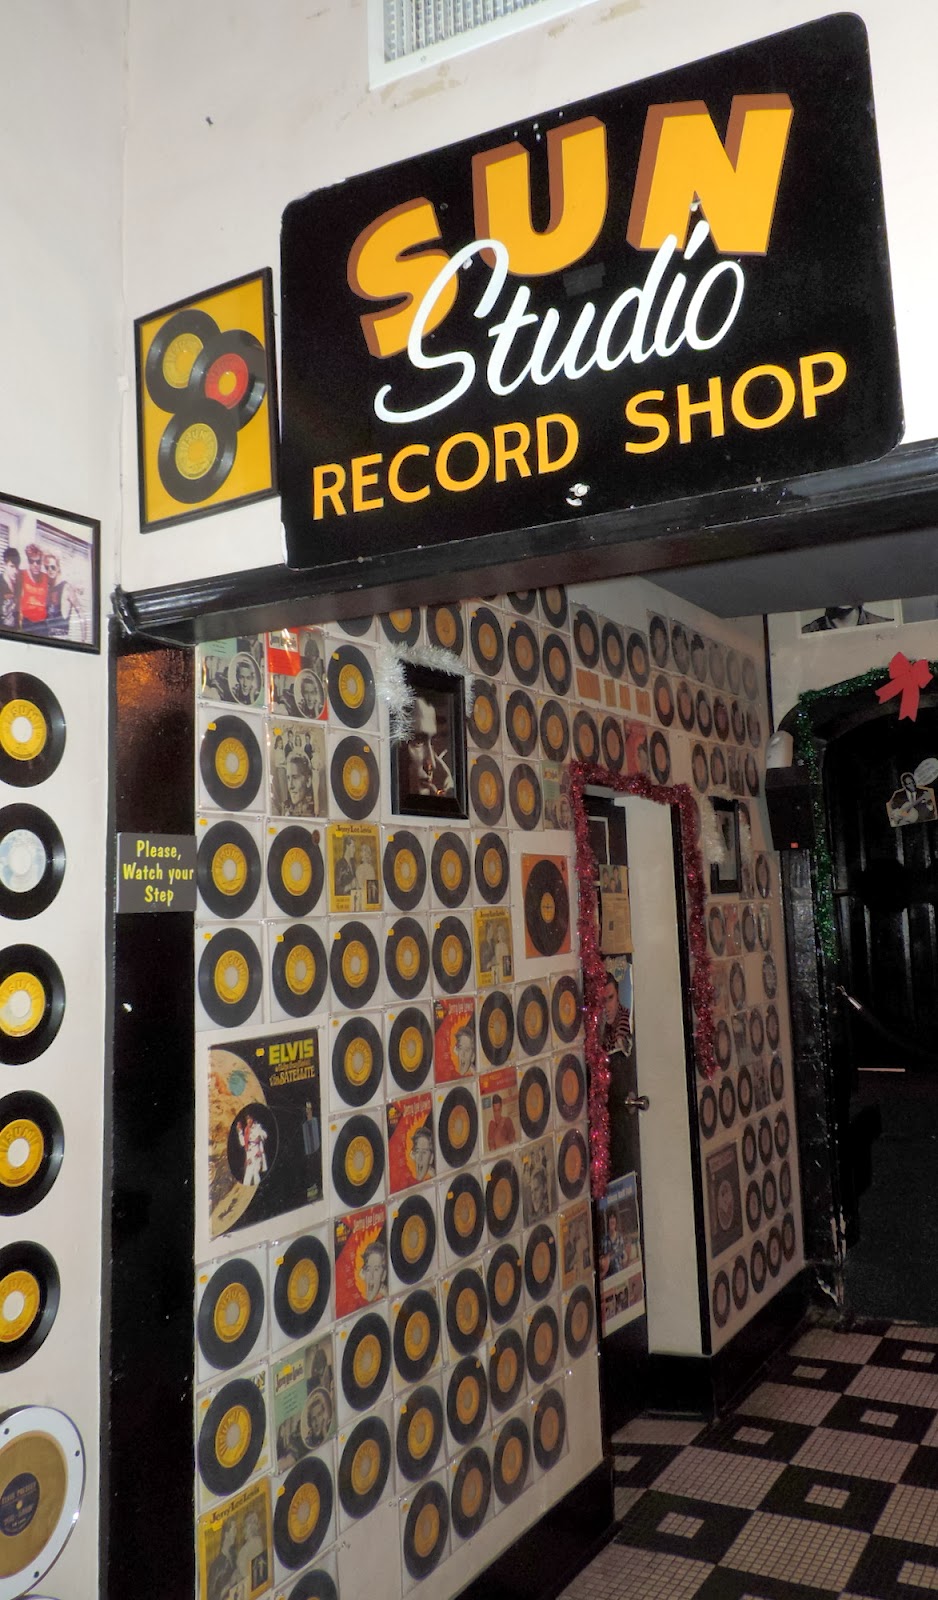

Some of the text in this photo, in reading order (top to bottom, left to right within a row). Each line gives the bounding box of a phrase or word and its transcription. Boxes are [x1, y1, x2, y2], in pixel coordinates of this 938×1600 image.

[347, 94, 794, 359] SUN
[374, 220, 745, 423] Studio
[312, 351, 848, 521] RECORD SHOP
[136, 839, 182, 861] Please,
[123, 862, 194, 885] Watch your
[144, 885, 174, 907] Step
[269, 1038, 314, 1066] ELVIS
